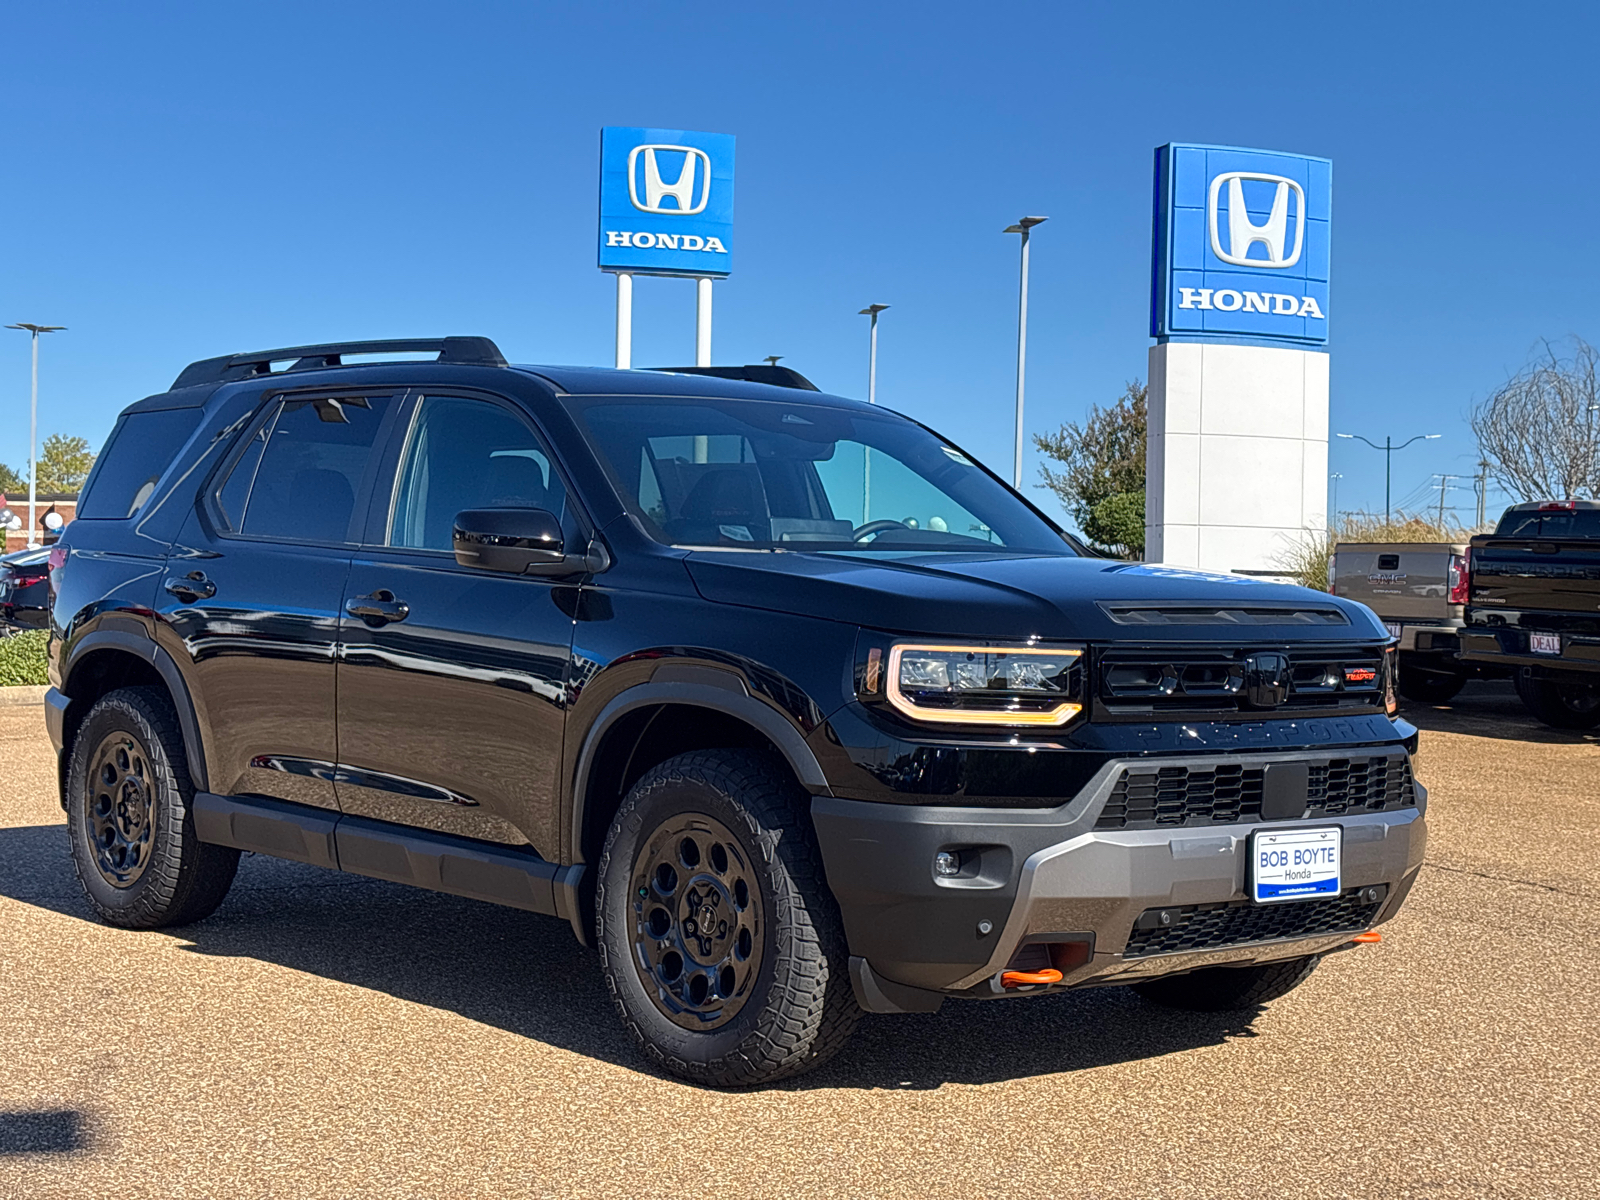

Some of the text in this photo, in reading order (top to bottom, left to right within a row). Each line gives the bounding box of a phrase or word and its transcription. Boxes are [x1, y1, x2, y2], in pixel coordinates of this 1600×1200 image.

[606, 231, 728, 254] HONDA
[1178, 287, 1325, 319] HONDA
[1367, 573, 1407, 585] GMC
[1260, 847, 1336, 868] BOB BOYTE
[1284, 868, 1312, 881] Honda
